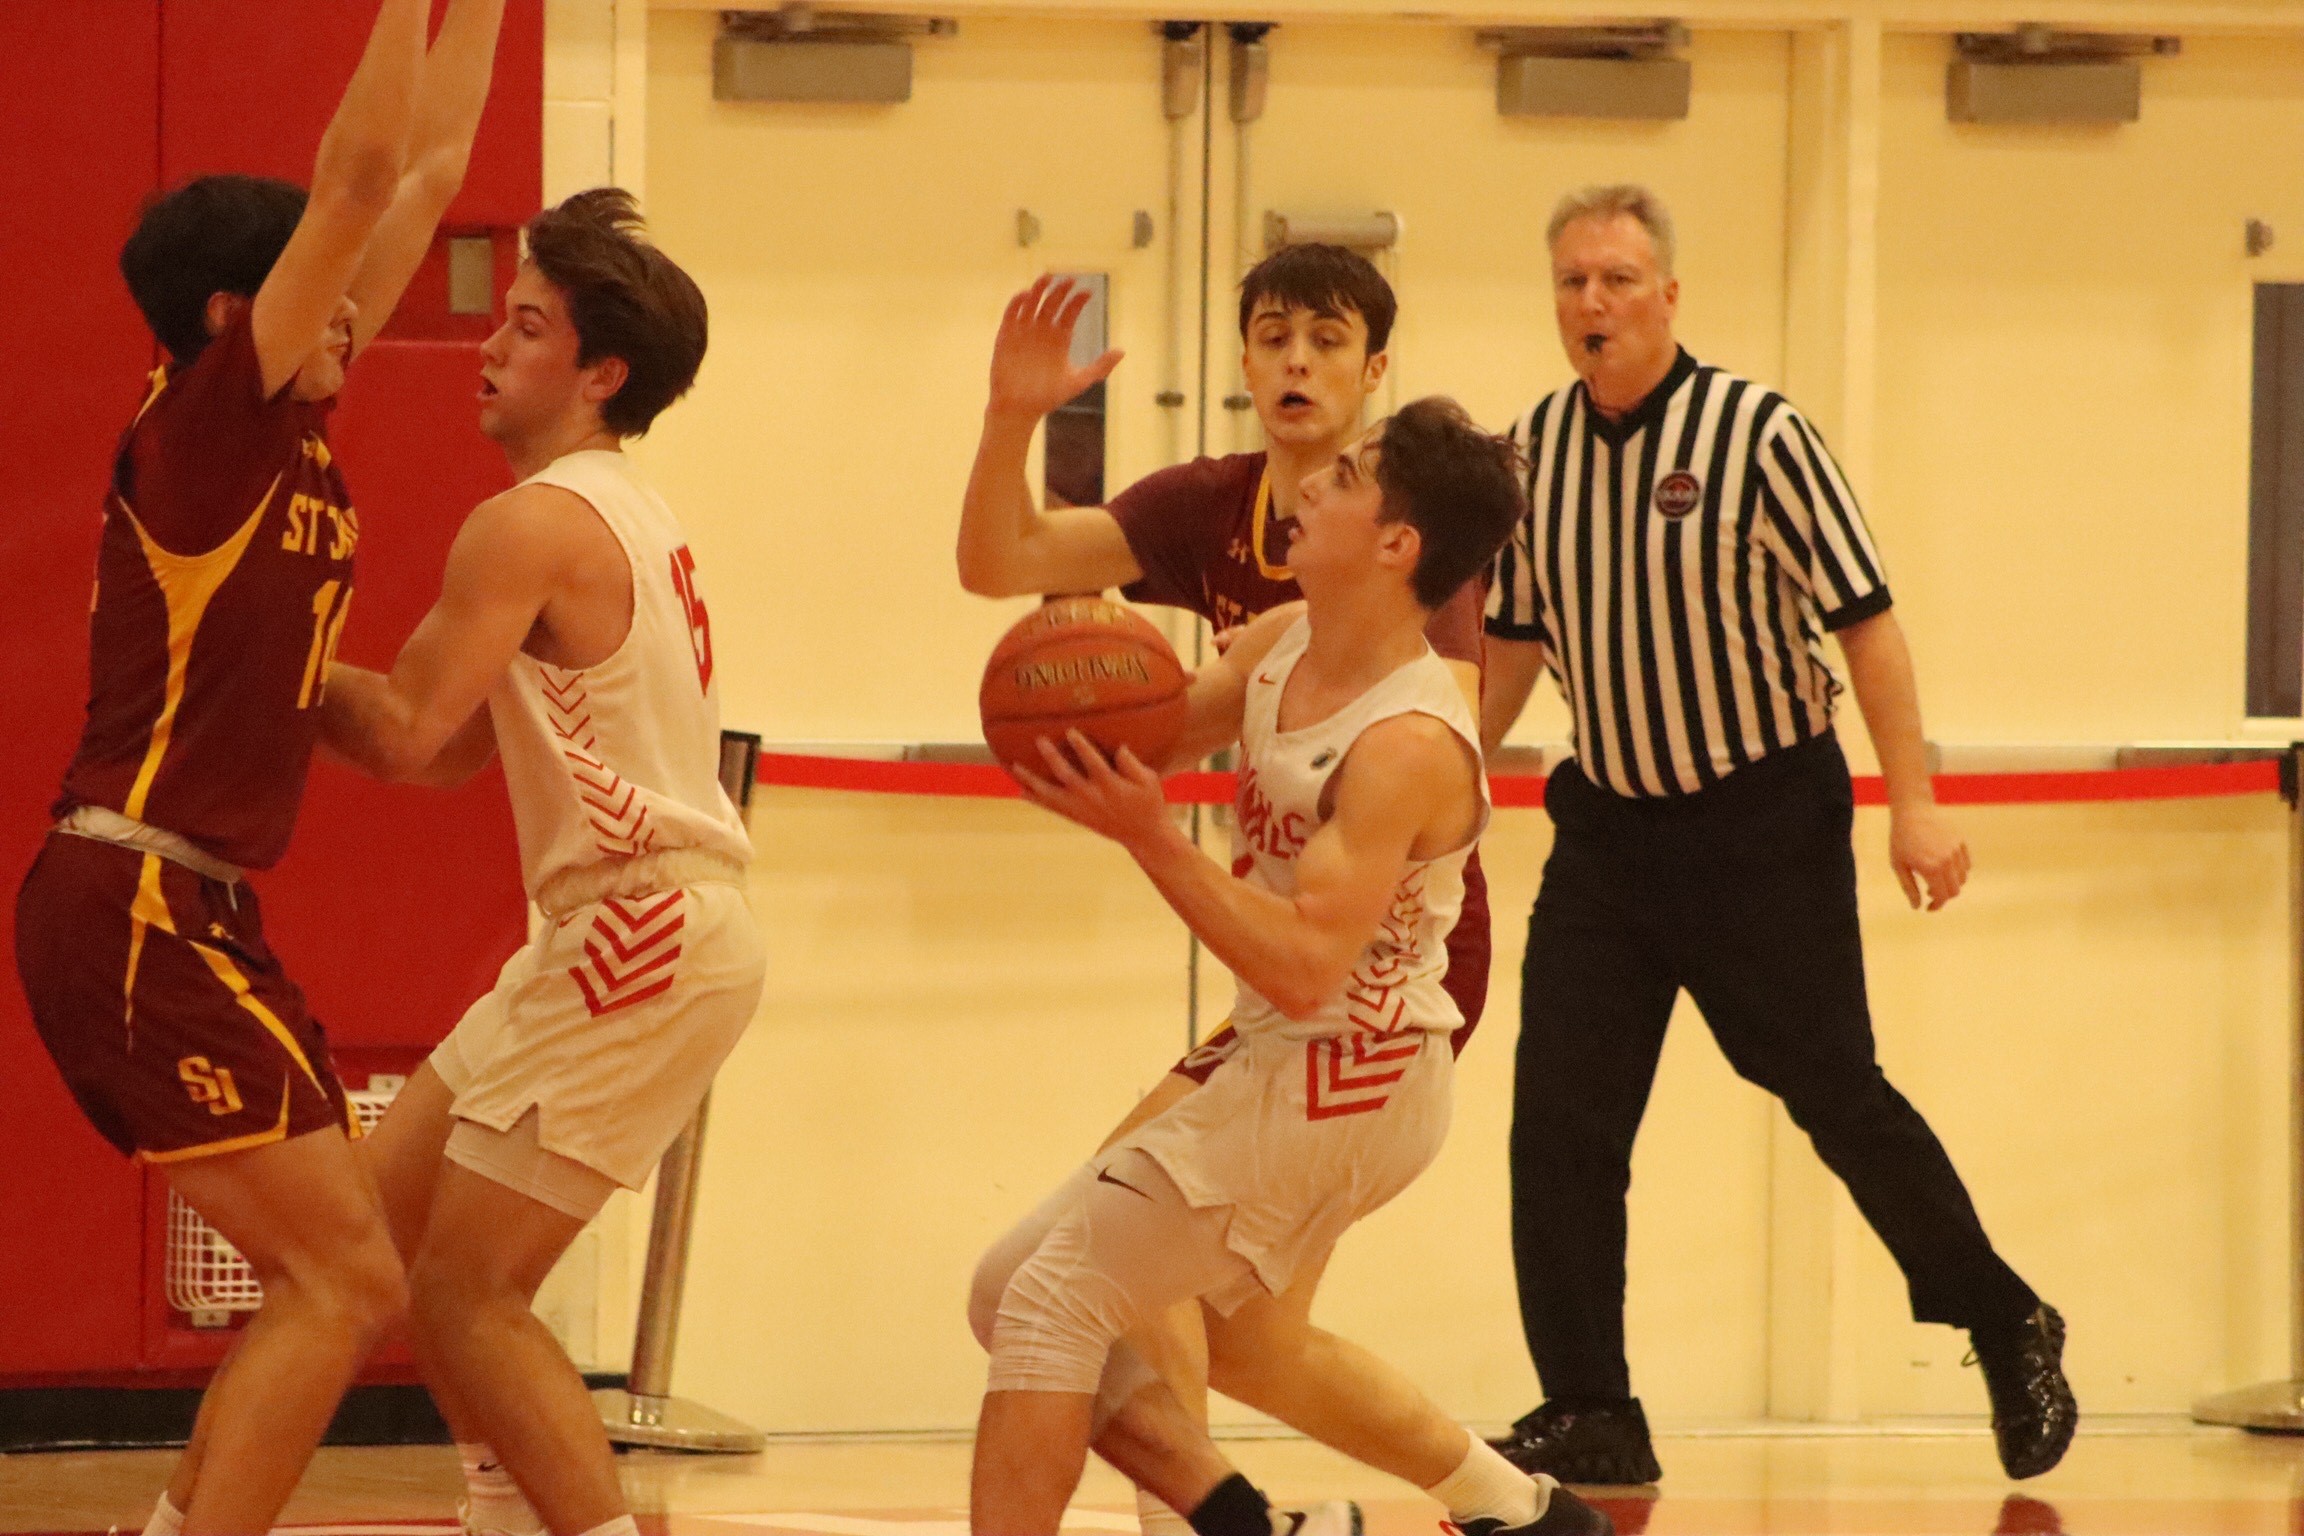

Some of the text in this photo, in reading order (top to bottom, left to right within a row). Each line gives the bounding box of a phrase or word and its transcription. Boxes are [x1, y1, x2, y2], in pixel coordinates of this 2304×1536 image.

[282, 492, 324, 556] ST
[668, 542, 713, 698] 15
[178, 1056, 244, 1116] SJ
